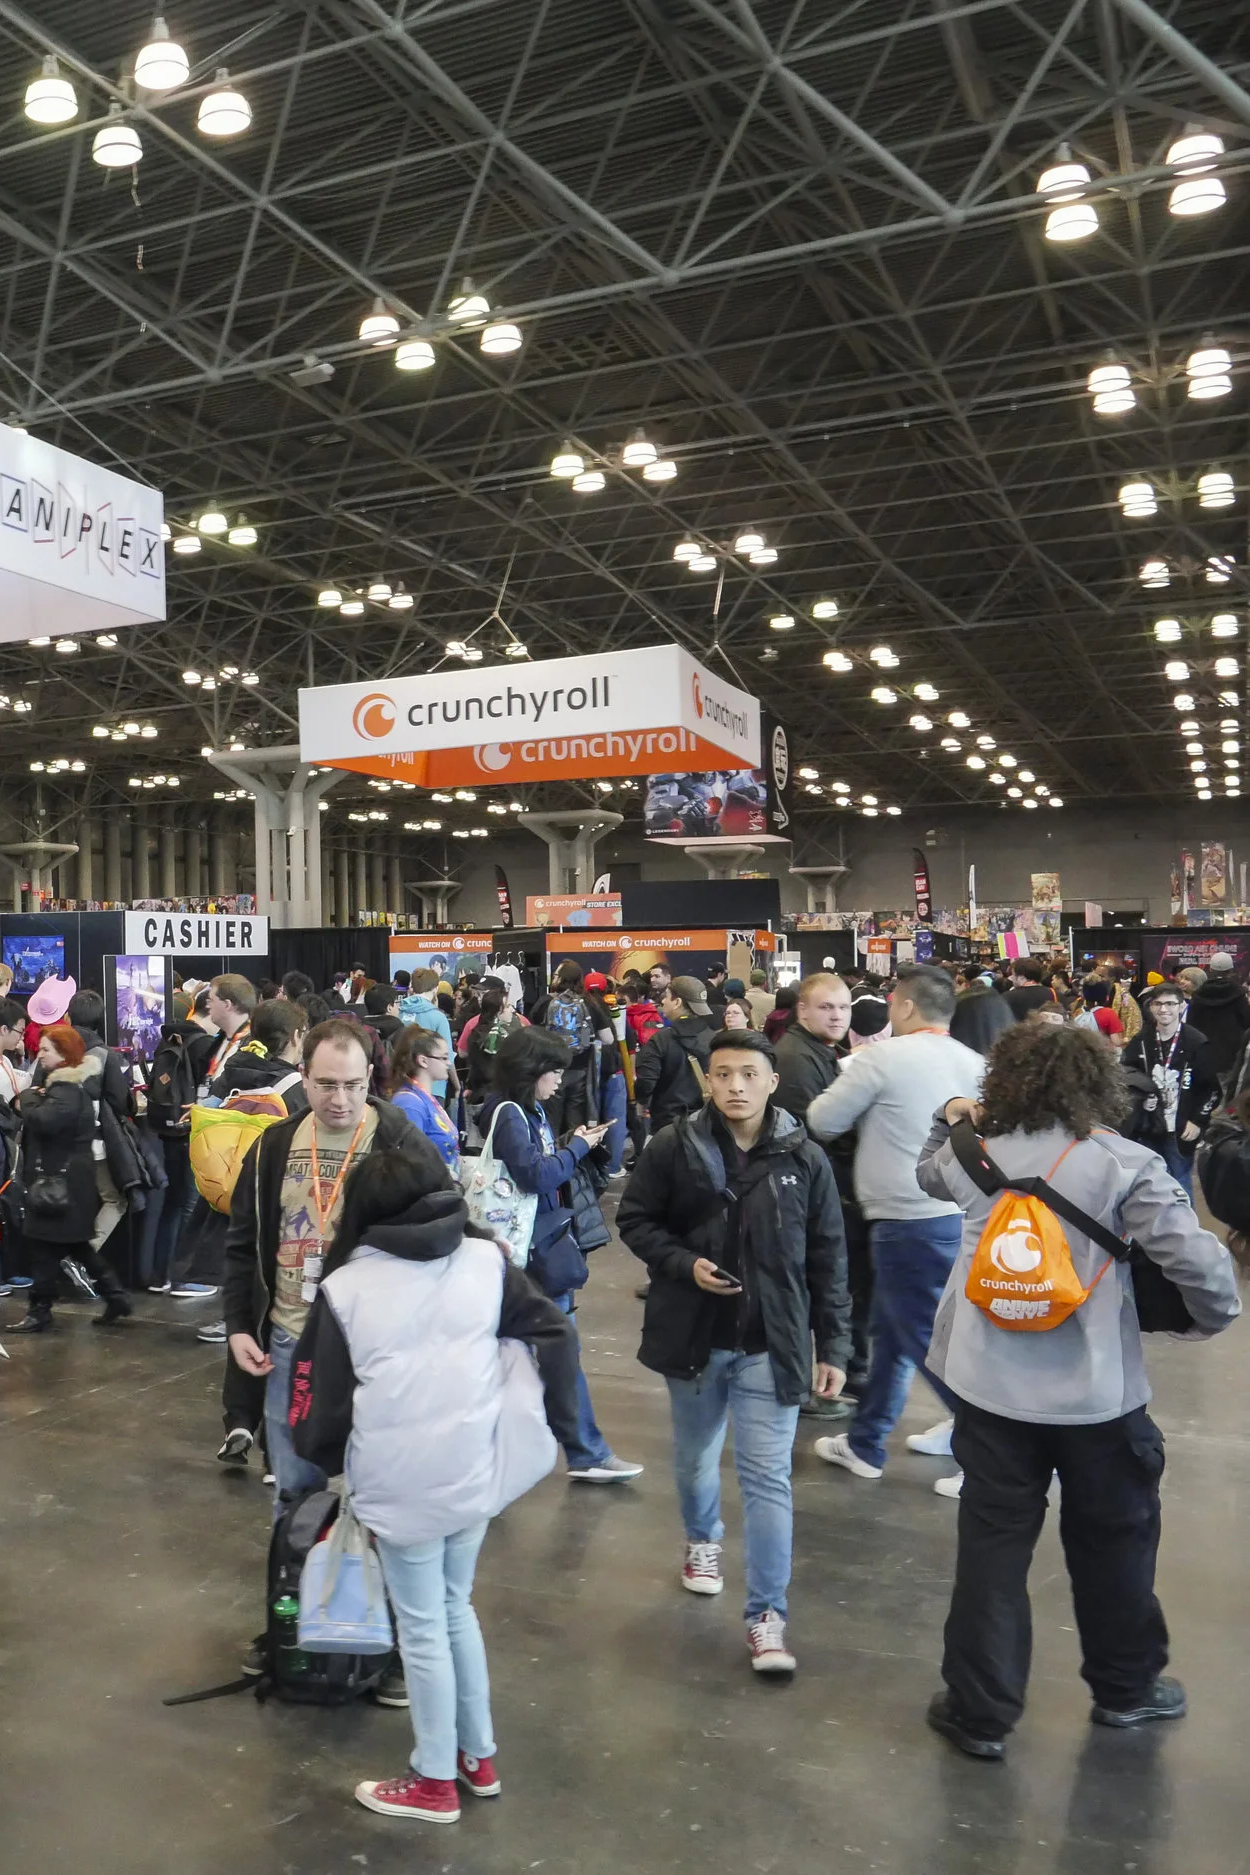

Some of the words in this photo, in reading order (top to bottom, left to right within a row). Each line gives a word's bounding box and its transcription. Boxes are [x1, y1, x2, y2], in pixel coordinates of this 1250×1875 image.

[5, 487, 159, 570] ANIPLEX
[407, 675, 610, 727] crunchyroll
[704, 695, 749, 740] crunchyroll
[520, 728, 697, 762] crunchyroll
[545, 899, 586, 908] crunchyroll
[144, 918, 253, 948] CASHIER
[582, 940, 605, 948] WATCH
[634, 936, 690, 951] crunchyroll
[980, 1277, 1053, 1294] crunchyroll
